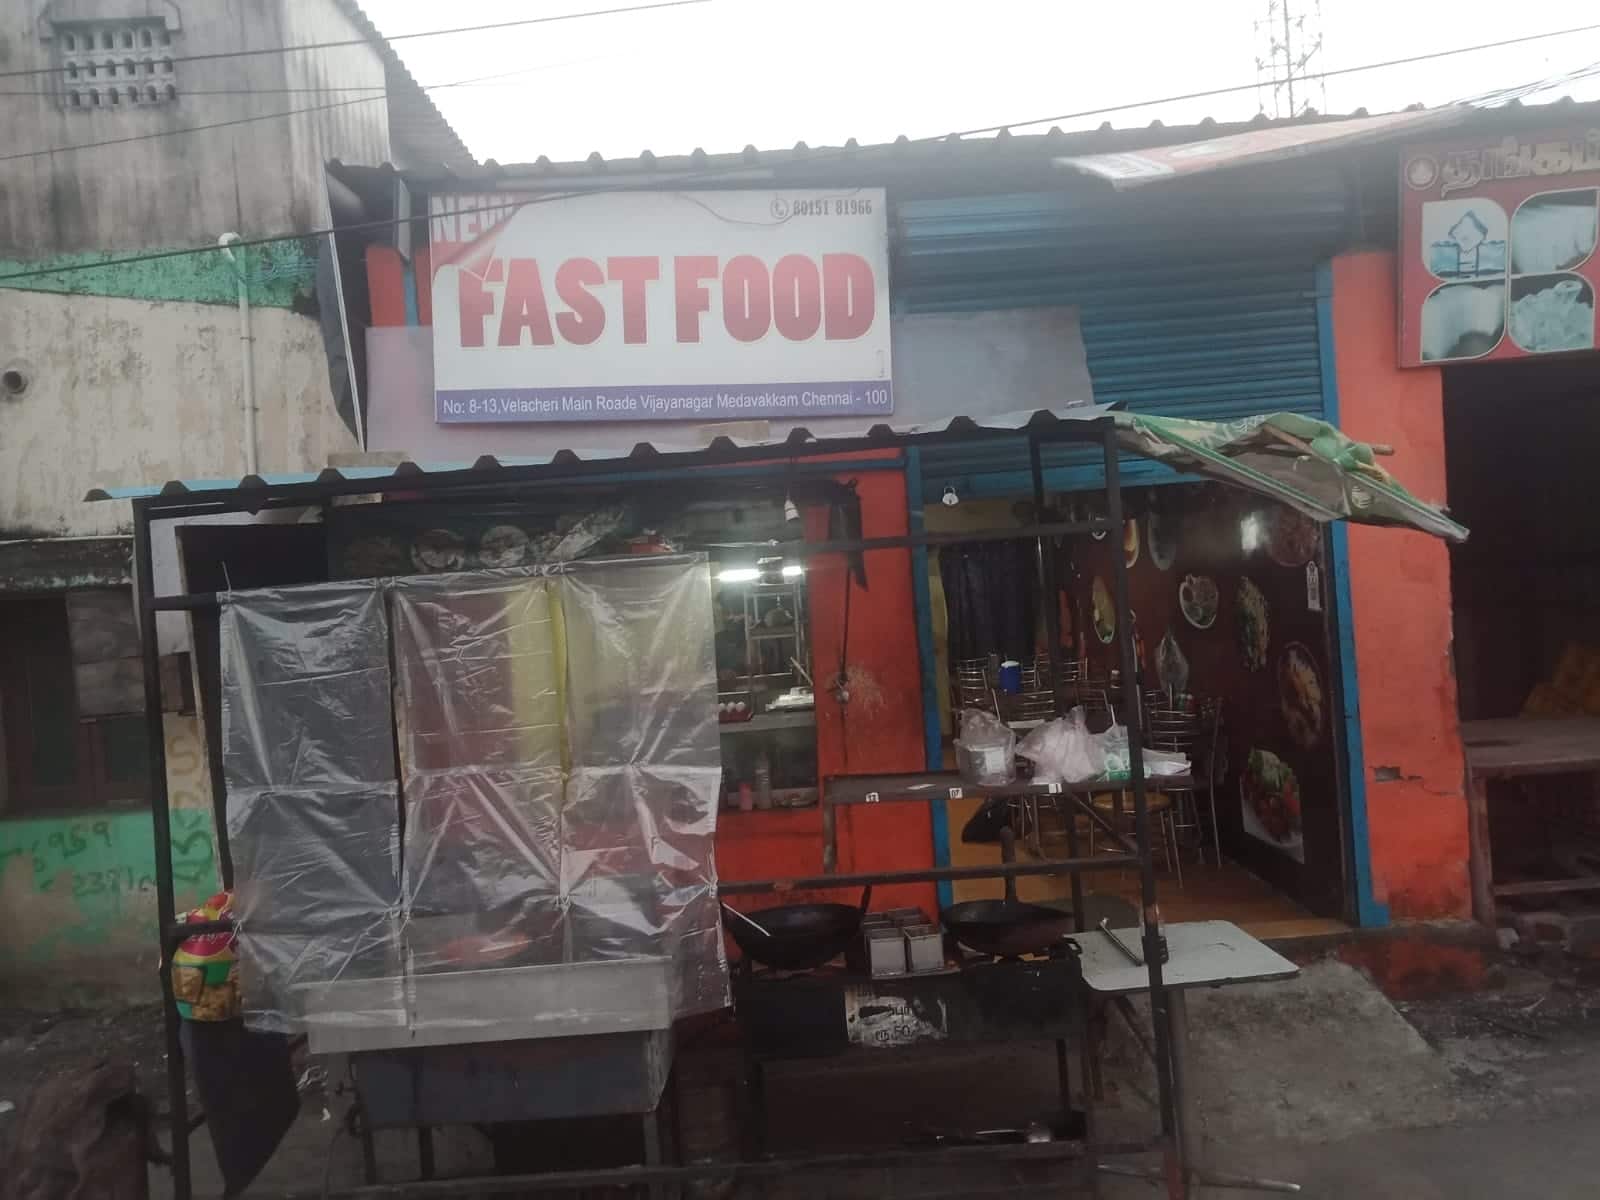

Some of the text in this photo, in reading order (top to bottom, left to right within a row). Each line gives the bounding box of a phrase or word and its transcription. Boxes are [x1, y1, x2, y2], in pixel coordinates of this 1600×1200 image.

[793, 199, 873, 216] 80151 81966
[458, 252, 876, 348] FAST FOOD
[443, 399, 466, 415] No:
[562, 395, 593, 412] Main
[596, 394, 637, 411] Roade
[640, 394, 713, 413] Vijayanagar
[717, 391, 799, 409] Medavakkam
[801, 390, 854, 407] Chennai
[865, 389, 888, 405] 100
